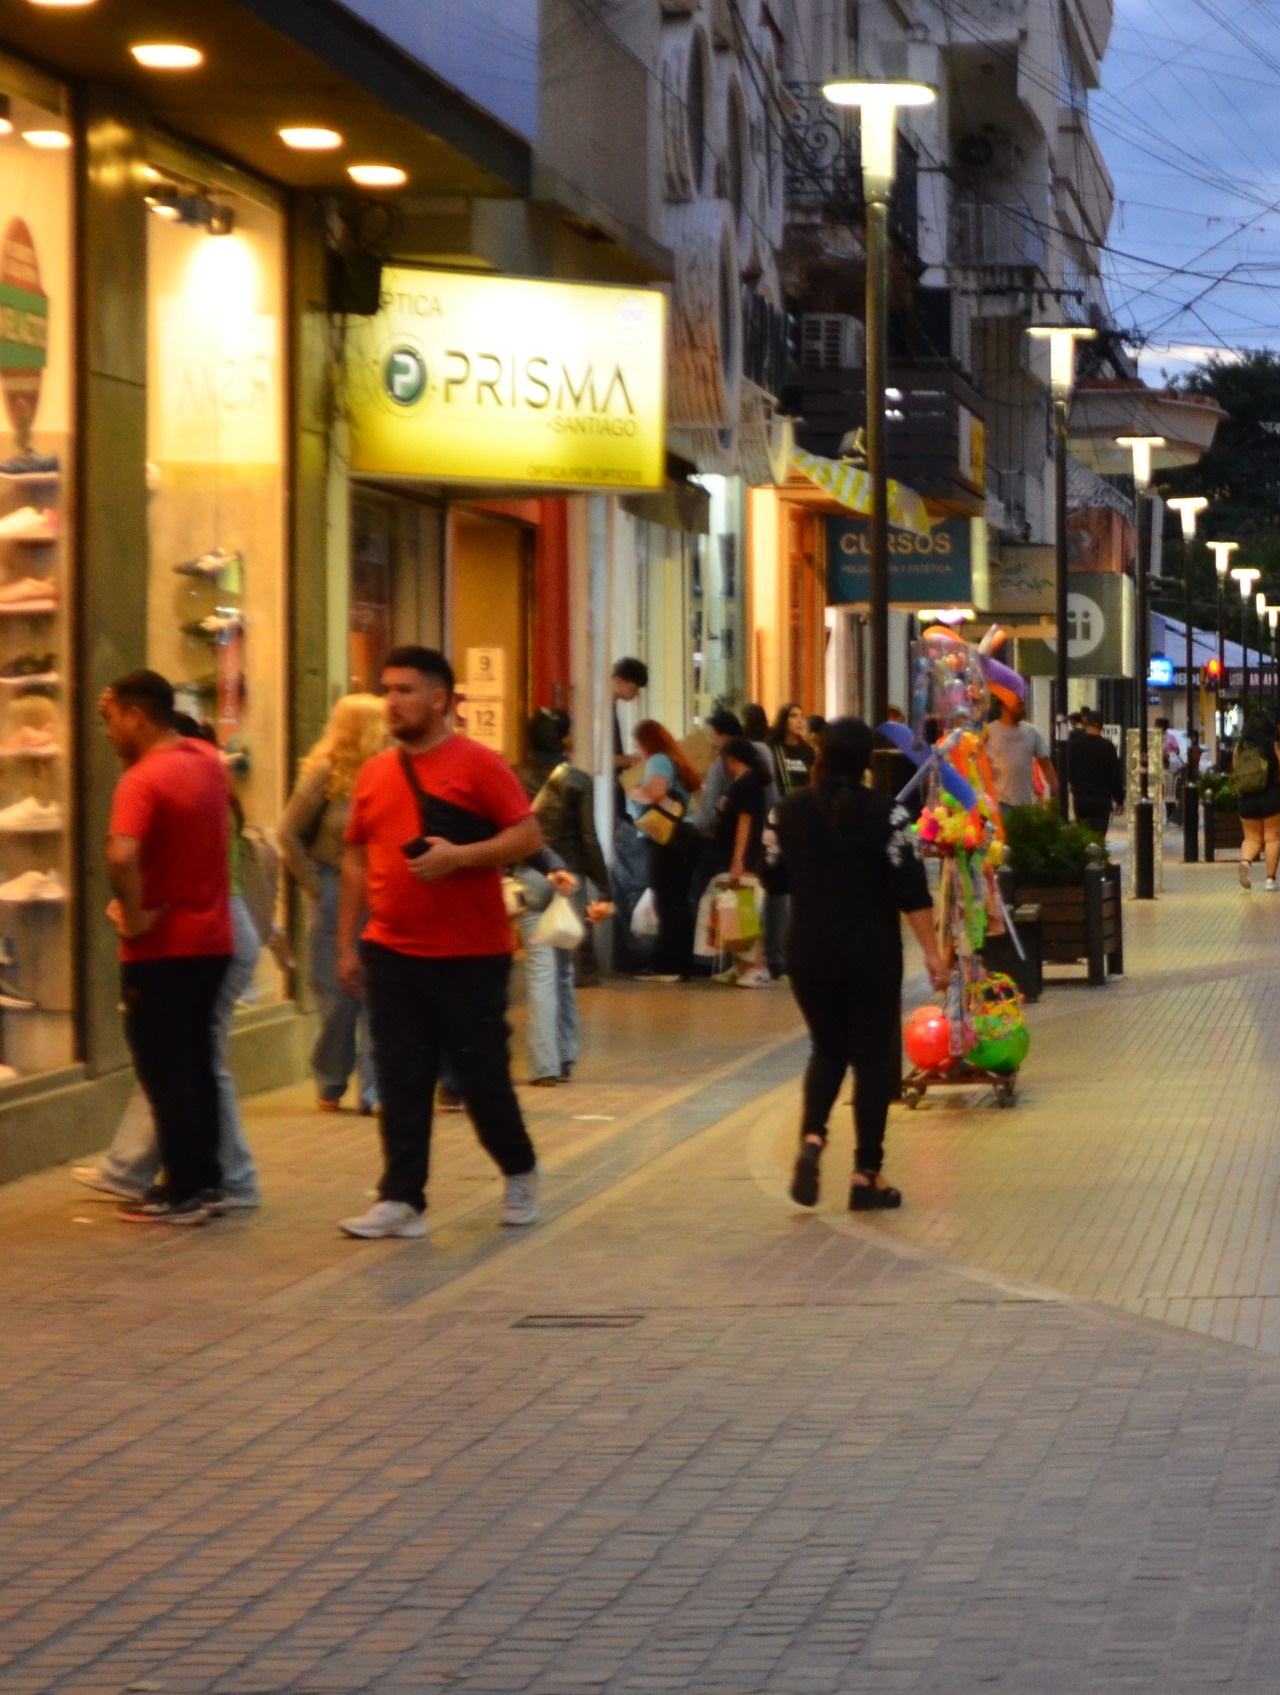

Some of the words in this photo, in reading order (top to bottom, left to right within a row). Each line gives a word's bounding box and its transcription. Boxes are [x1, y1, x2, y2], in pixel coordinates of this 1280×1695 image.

[381, 290, 445, 318] PTICA
[443, 349, 635, 416] PRISMA
[840, 532, 952, 555] CURSOS
[476, 709, 497, 728] 12
